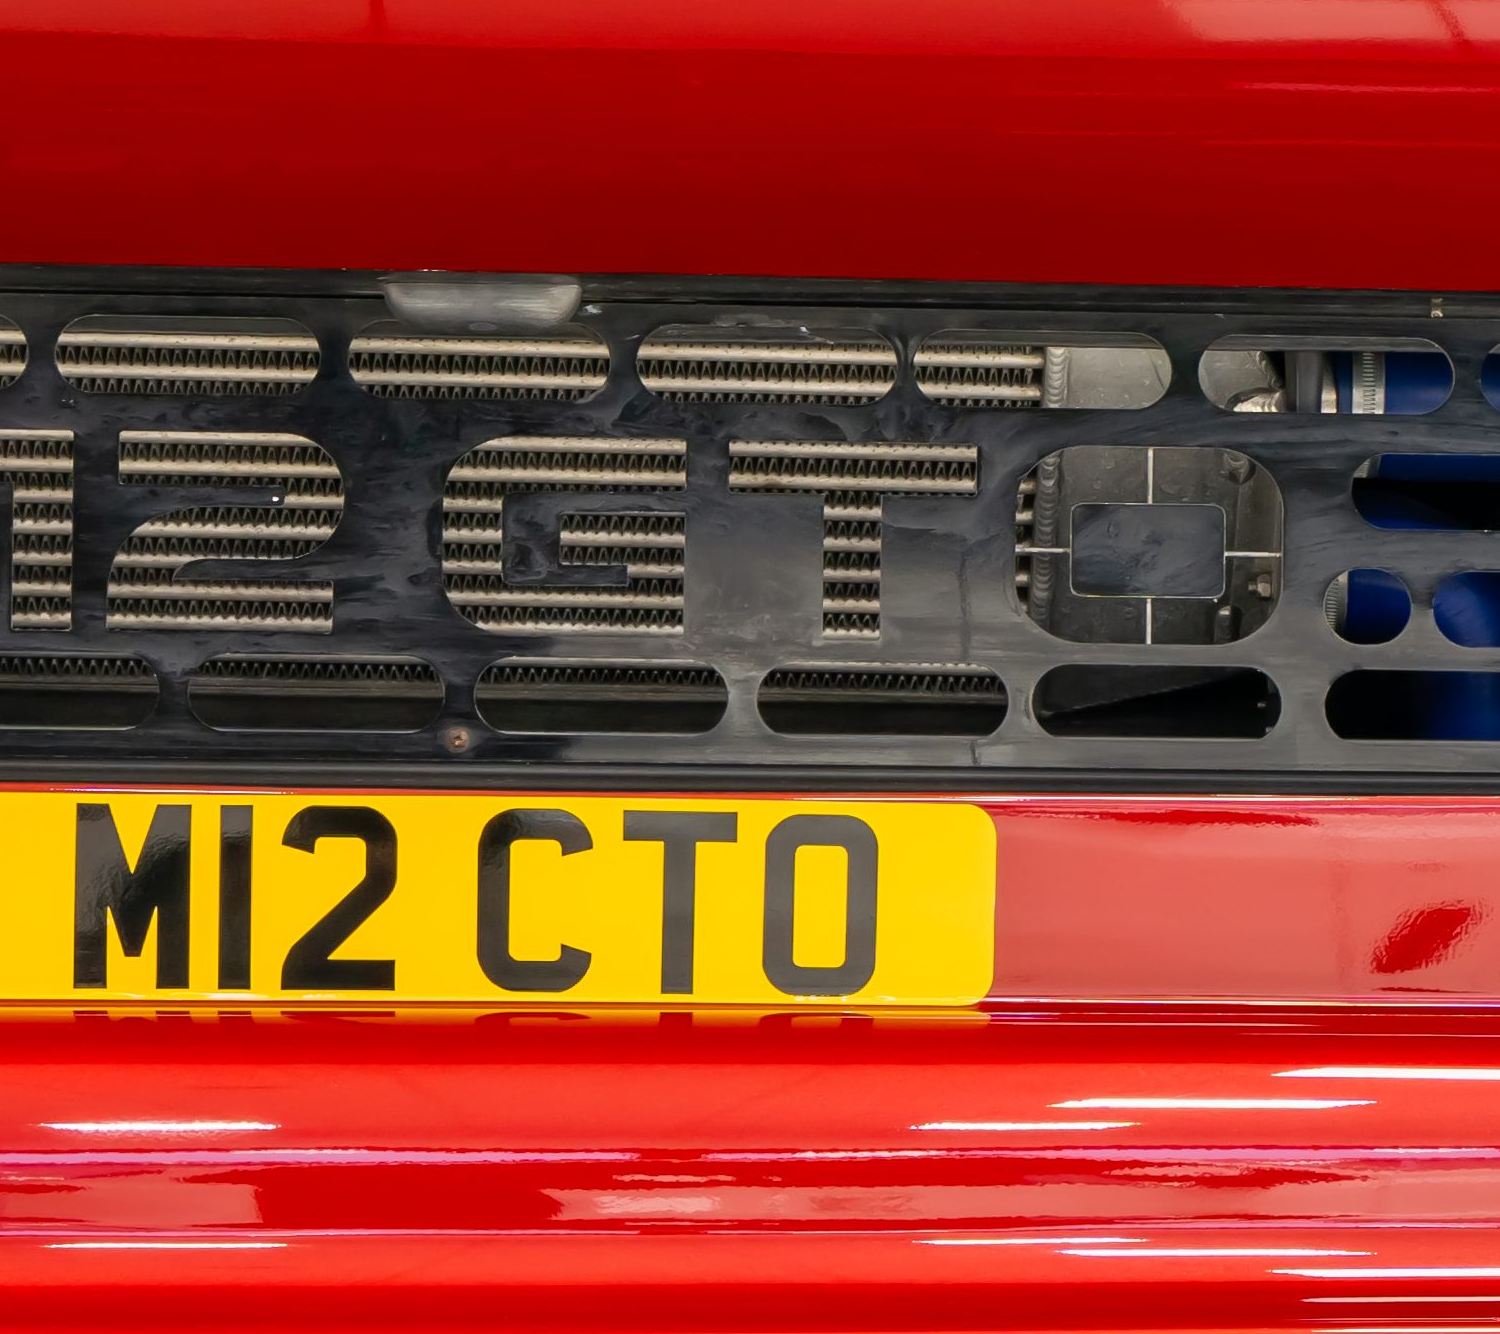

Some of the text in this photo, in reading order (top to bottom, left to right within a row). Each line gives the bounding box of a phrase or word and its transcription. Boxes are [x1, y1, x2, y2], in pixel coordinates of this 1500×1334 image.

[442, 435, 1284, 645] GTO
[72, 802, 879, 997] M12 CTO
